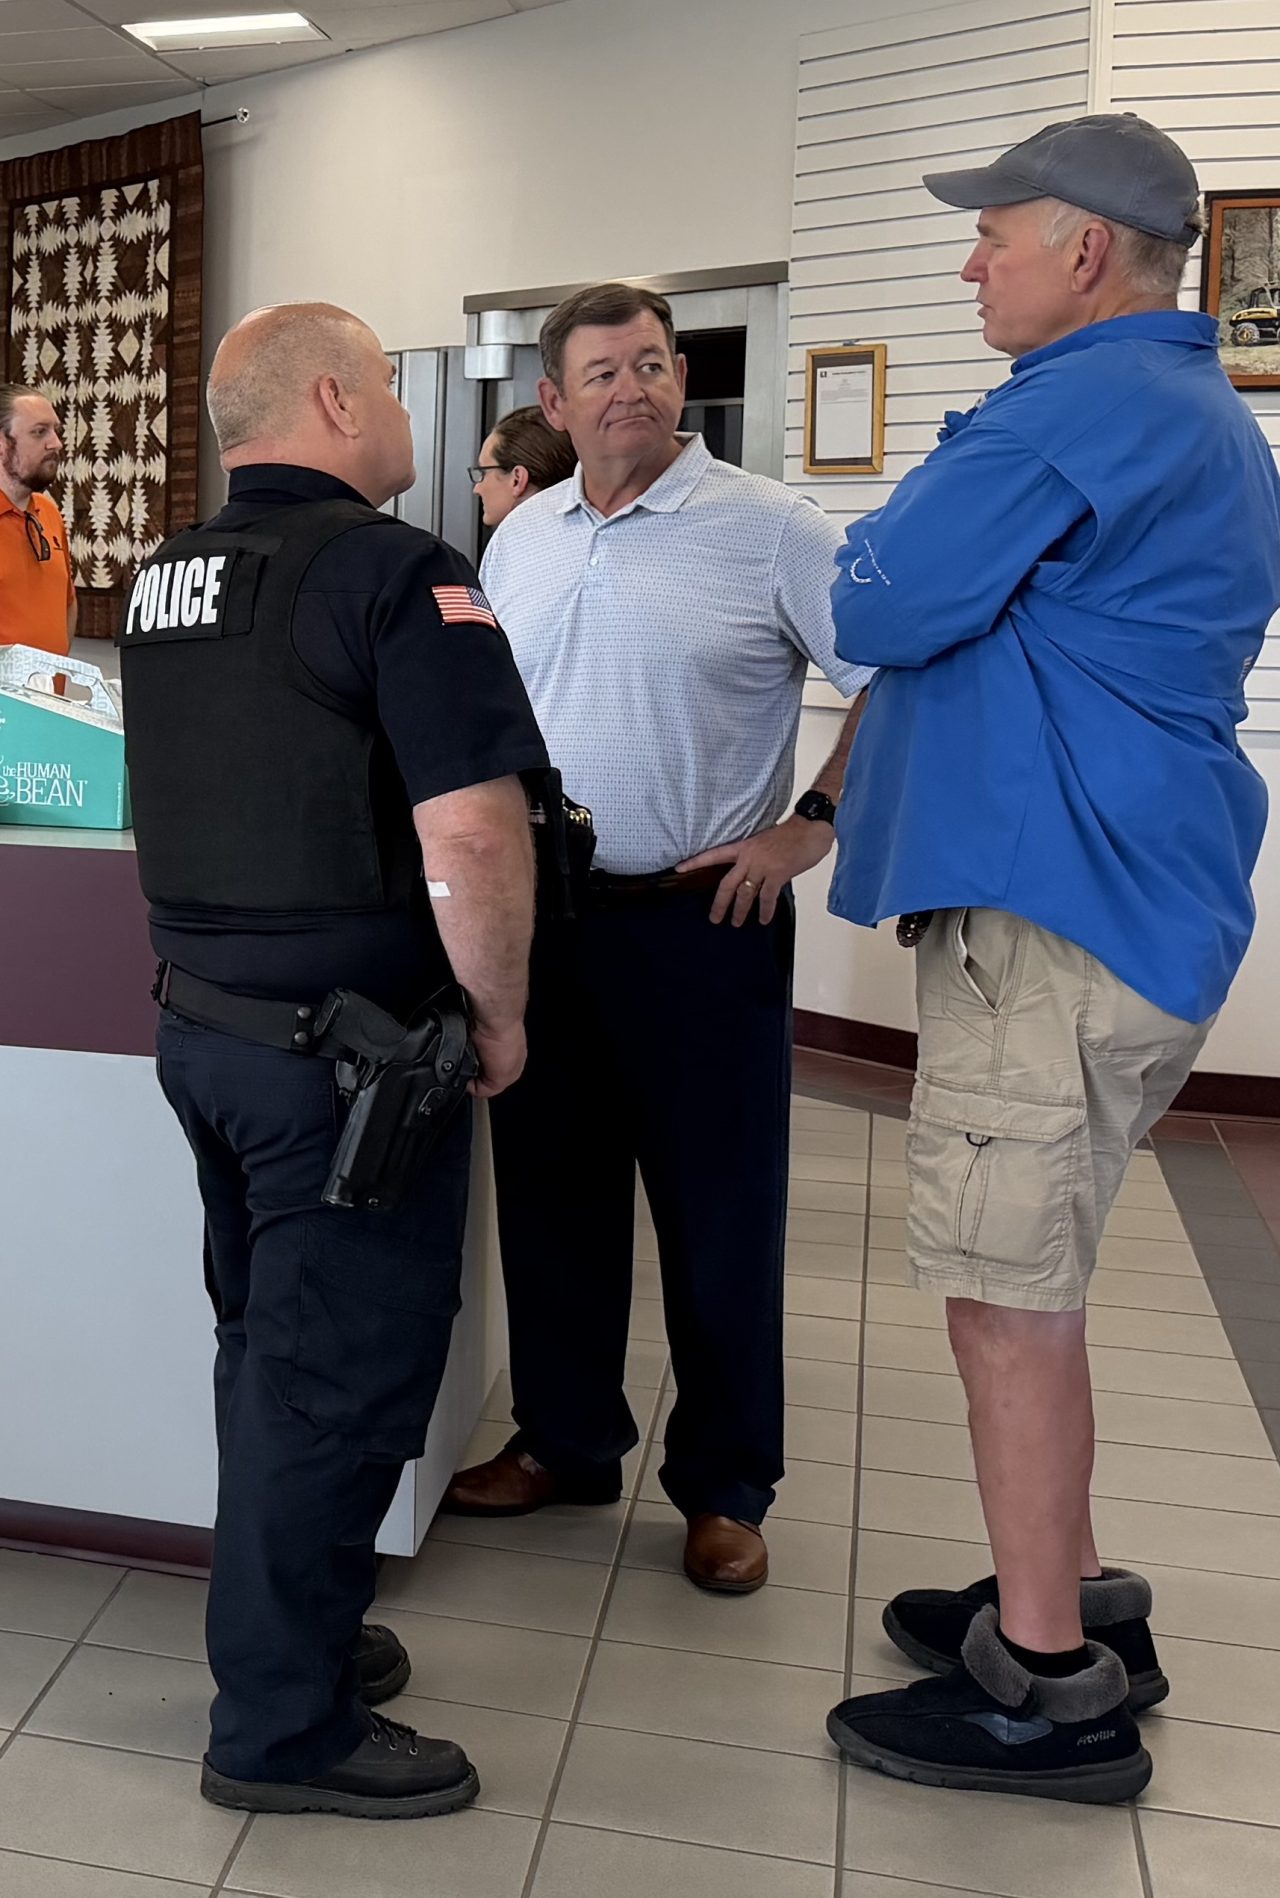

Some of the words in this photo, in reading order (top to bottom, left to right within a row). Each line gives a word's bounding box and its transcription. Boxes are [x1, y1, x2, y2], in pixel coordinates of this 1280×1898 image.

[125, 556, 226, 635] POLICE
[2, 765, 16, 777] the
[17, 762, 71, 779] HUMAN
[14, 776, 84, 807] BEAN
